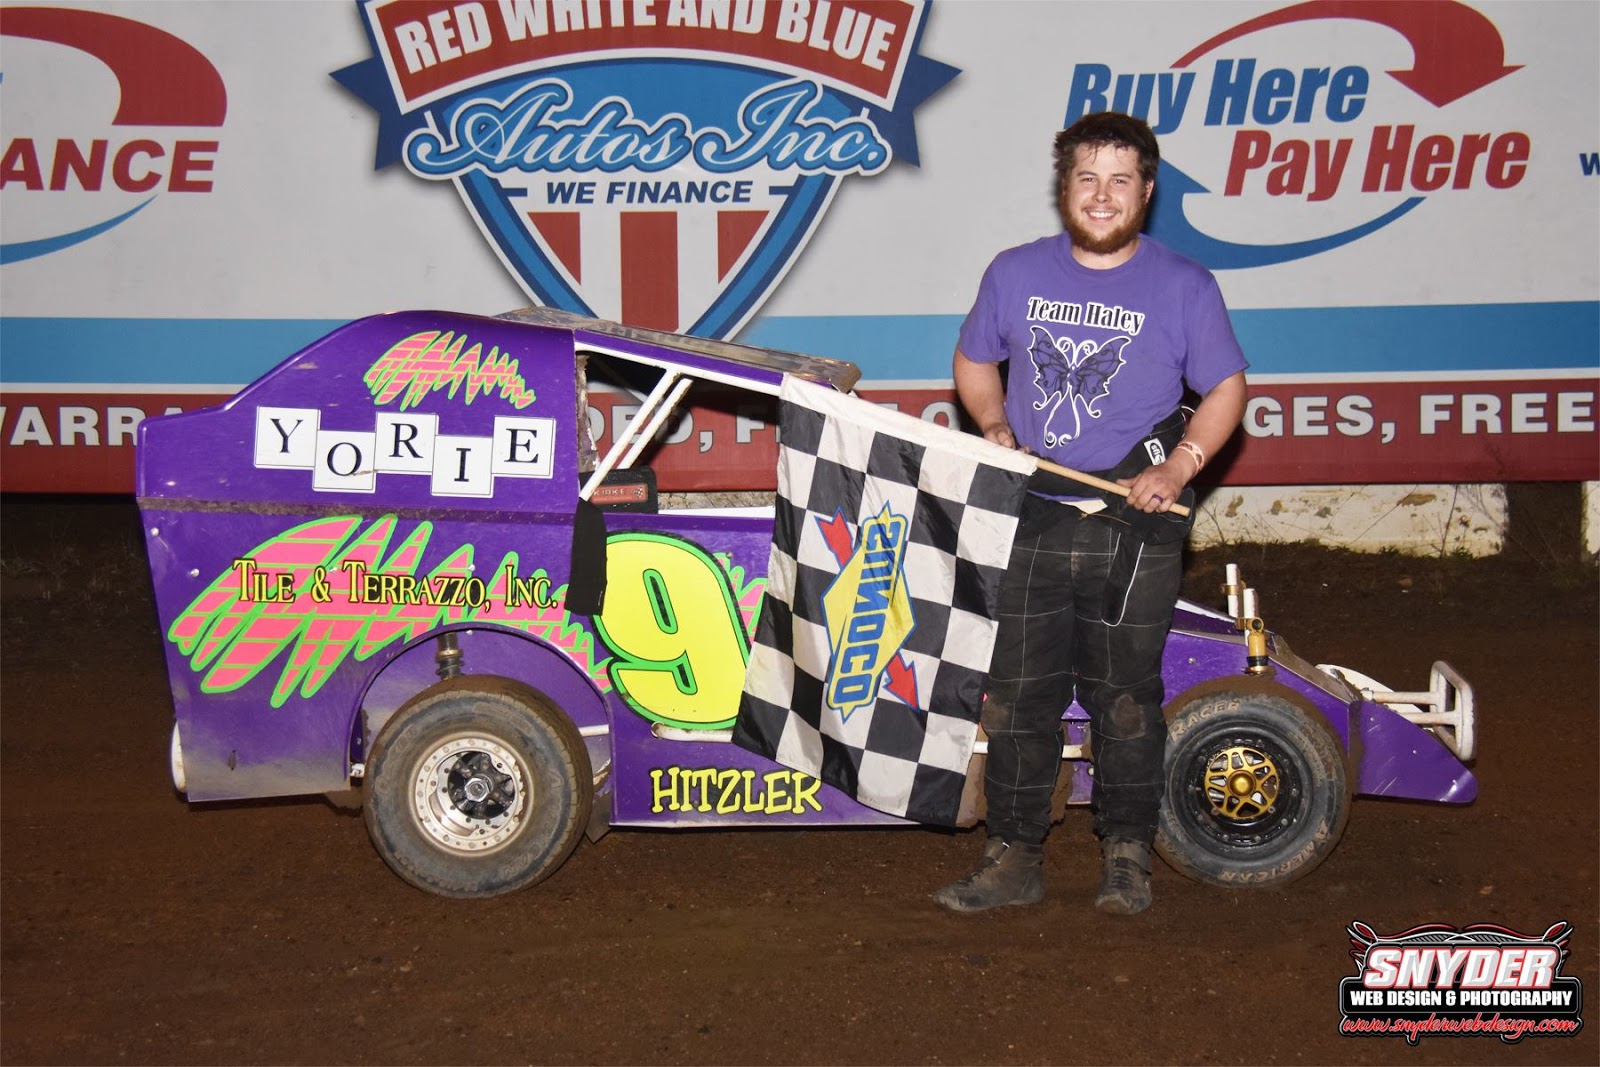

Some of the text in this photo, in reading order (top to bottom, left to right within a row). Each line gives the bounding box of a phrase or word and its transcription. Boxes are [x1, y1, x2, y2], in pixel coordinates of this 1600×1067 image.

[395, 2, 493, 74] RED
[667, 0, 767, 34] AND
[775, 0, 897, 72] BLUE
[410, 80, 884, 172] Autos Inc.
[1063, 58, 1370, 136] Buy Here
[546, 180, 753, 205] WE FINANCE
[1223, 125, 1532, 202] Pay Here
[1028, 297, 1145, 335] Team Haley
[1419, 391, 1596, 435] FREE
[270, 417, 540, 483] YORIE
[233, 559, 559, 612] TILE & TERRAZZO, INC.
[598, 529, 750, 733] 9
[1167, 698, 1242, 742] RACER
[649, 766, 824, 815] HITZLER
